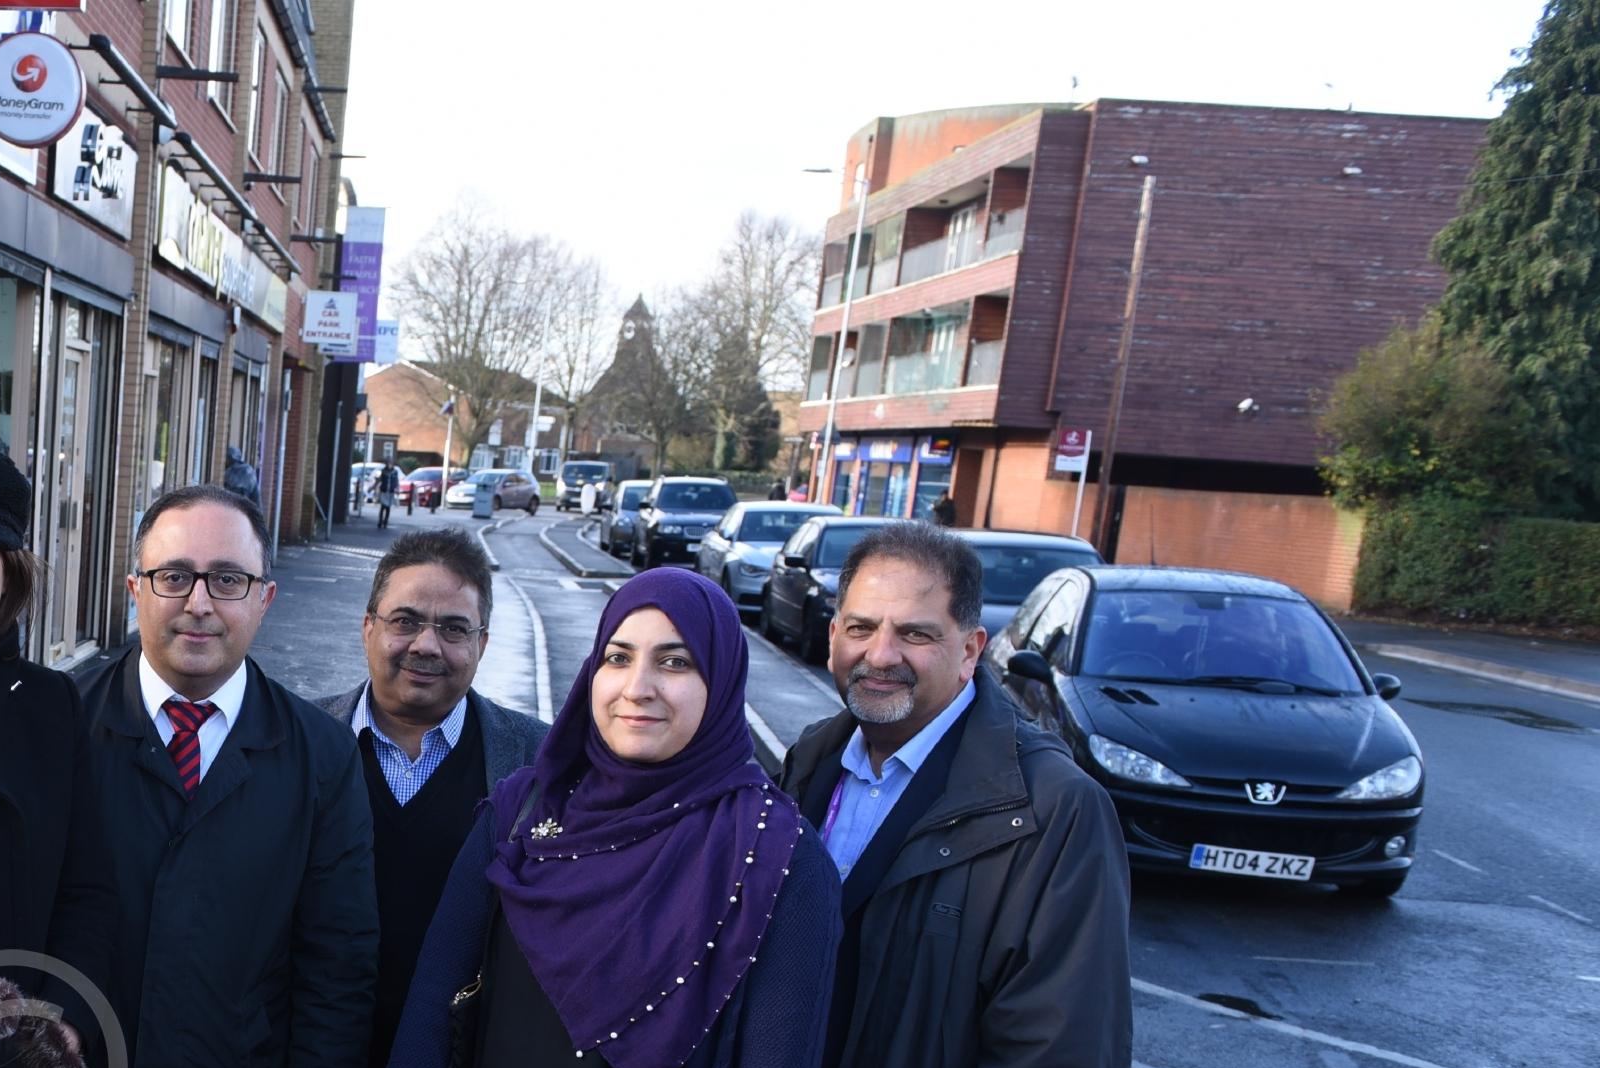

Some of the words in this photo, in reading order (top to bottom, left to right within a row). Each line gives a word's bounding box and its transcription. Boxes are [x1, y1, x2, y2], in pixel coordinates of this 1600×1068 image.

[0, 111, 23, 119] money
[321, 310, 339, 318] CAR
[318, 320, 340, 328] PARK
[305, 330, 352, 340] ENTRANCE
[1204, 848, 1260, 871] HT04
[1265, 856, 1310, 877] ZKZ
